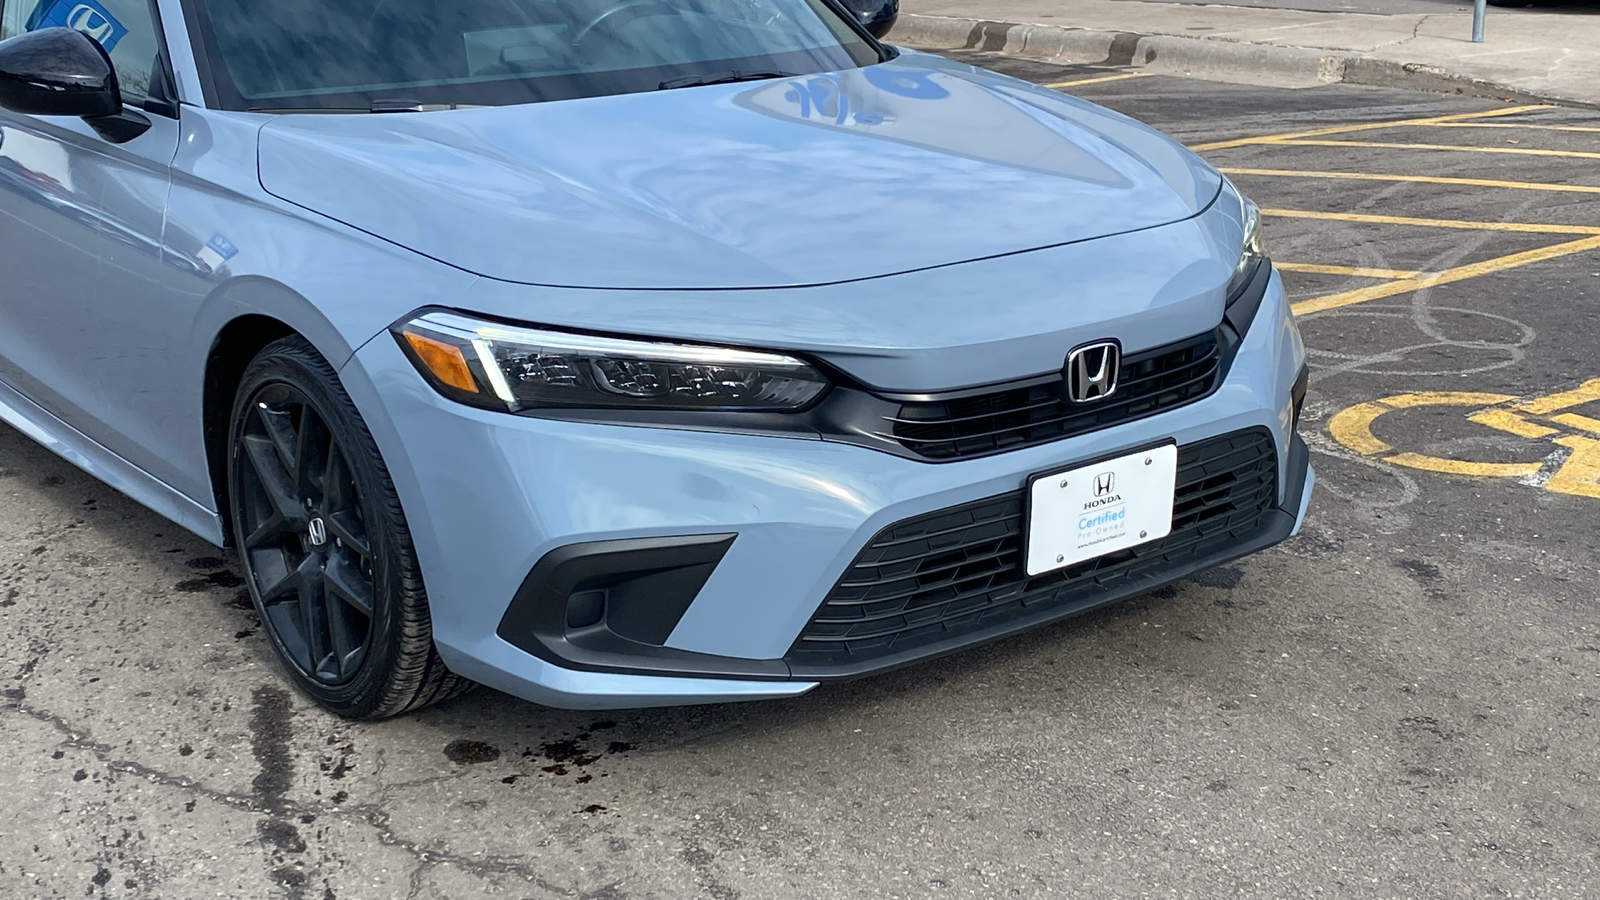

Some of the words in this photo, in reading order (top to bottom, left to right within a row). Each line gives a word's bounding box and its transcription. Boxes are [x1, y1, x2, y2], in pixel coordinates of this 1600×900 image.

[1083, 494, 1122, 510] HONDA
[1078, 506, 1126, 530] Certified
[1077, 521, 1124, 540] Pre-Owned
